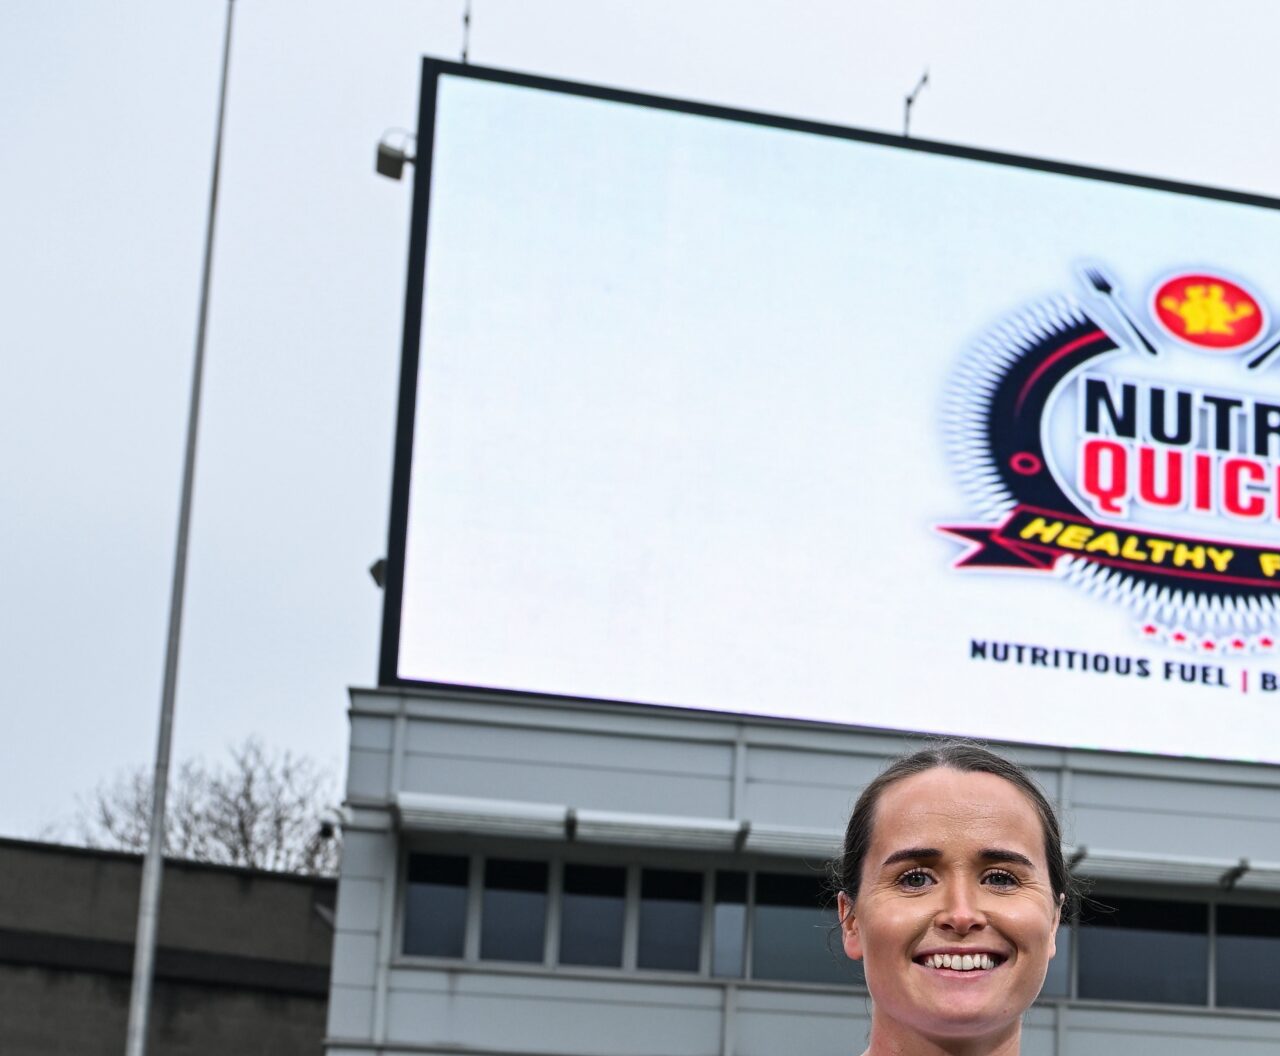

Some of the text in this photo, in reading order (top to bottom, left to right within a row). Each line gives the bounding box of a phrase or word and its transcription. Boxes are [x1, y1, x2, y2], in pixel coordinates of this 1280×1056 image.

[1020, 517, 1235, 572] HEALTHY
[970, 639, 1151, 679] NUTRITIOUS
[1163, 661, 1229, 687] FUEL
